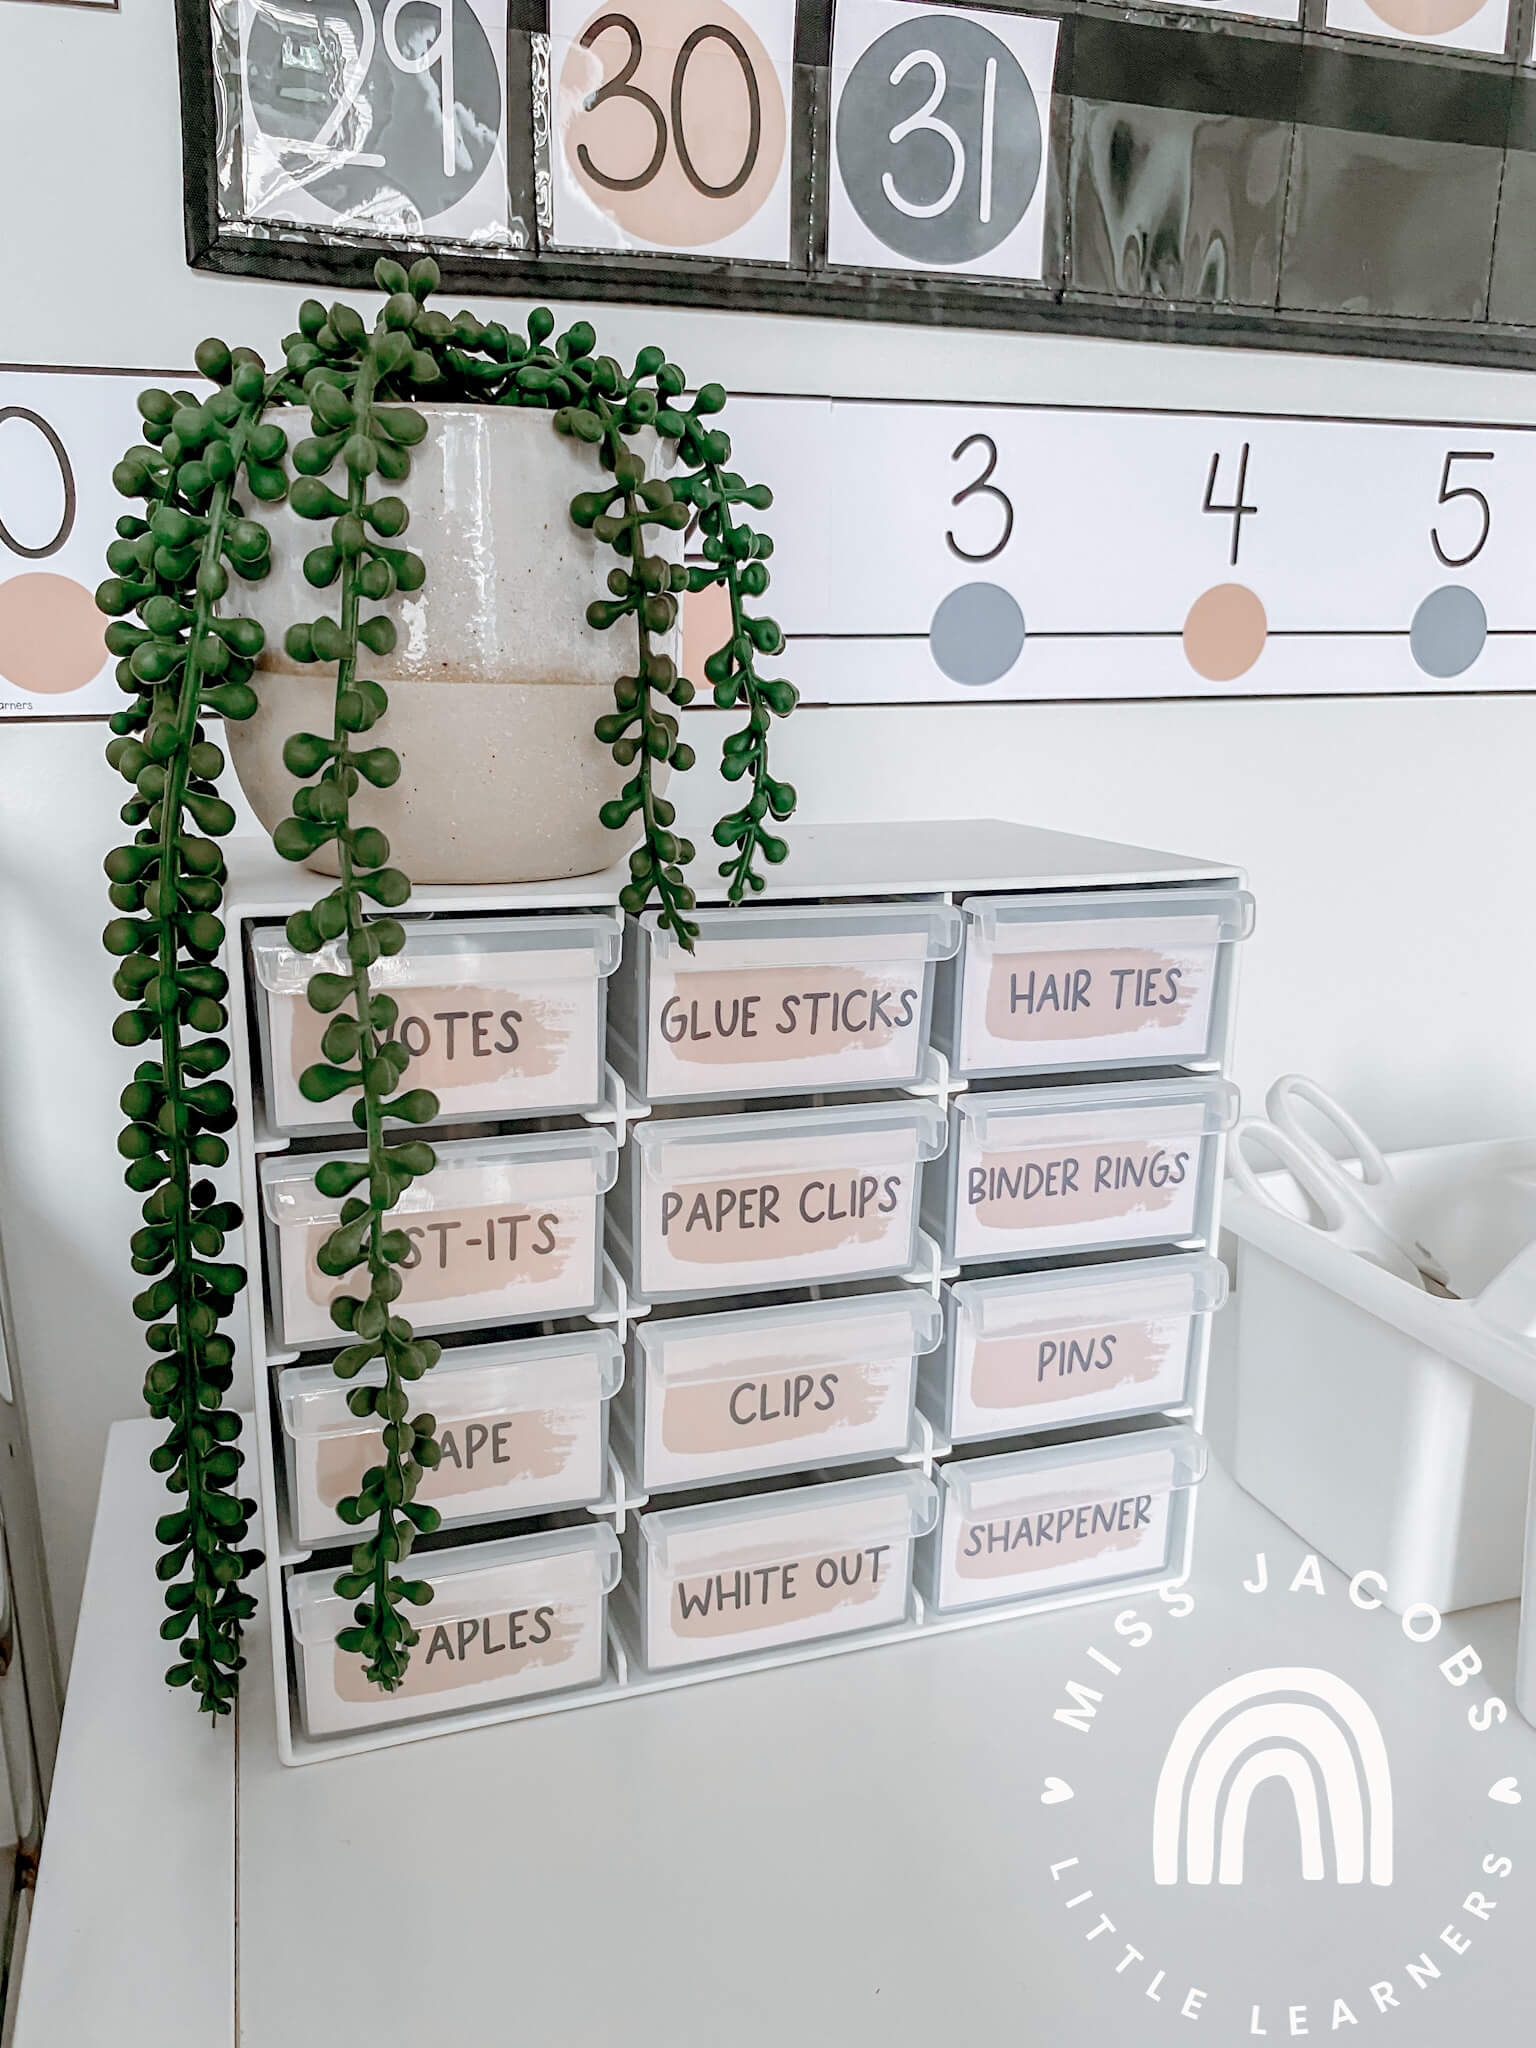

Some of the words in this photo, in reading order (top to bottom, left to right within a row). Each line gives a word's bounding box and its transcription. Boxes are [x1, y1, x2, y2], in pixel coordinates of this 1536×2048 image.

[307, 0, 455, 177] 29
[577, 13, 762, 199] 30
[881, 49, 997, 223] 31
[945, 433, 1014, 563] 3
[1202, 441, 1258, 566] 4
[1430, 451, 1495, 568] 5
[660, 993, 762, 1043] GLUE
[775, 987, 918, 1036] STICKS
[1009, 968, 1092, 1014] HAIR
[1110, 967, 1183, 1009] TIES
[661, 1184, 780, 1236] PAPER
[799, 1175, 901, 1222] CLIPS
[968, 1157, 1080, 1205] BINDER
[1093, 1150, 1190, 1192] RINGS
[338, 1213, 559, 1279] ST-ITS
[1037, 1334, 1118, 1382] PINS
[729, 1373, 840, 1426] CLIPS
[431, 1421, 513, 1472] APE
[963, 1494, 1153, 1557] SHARPENER
[677, 1563, 799, 1620] WHITE
[816, 1545, 890, 1588] OUT
[361, 1606, 555, 1672] APLES
